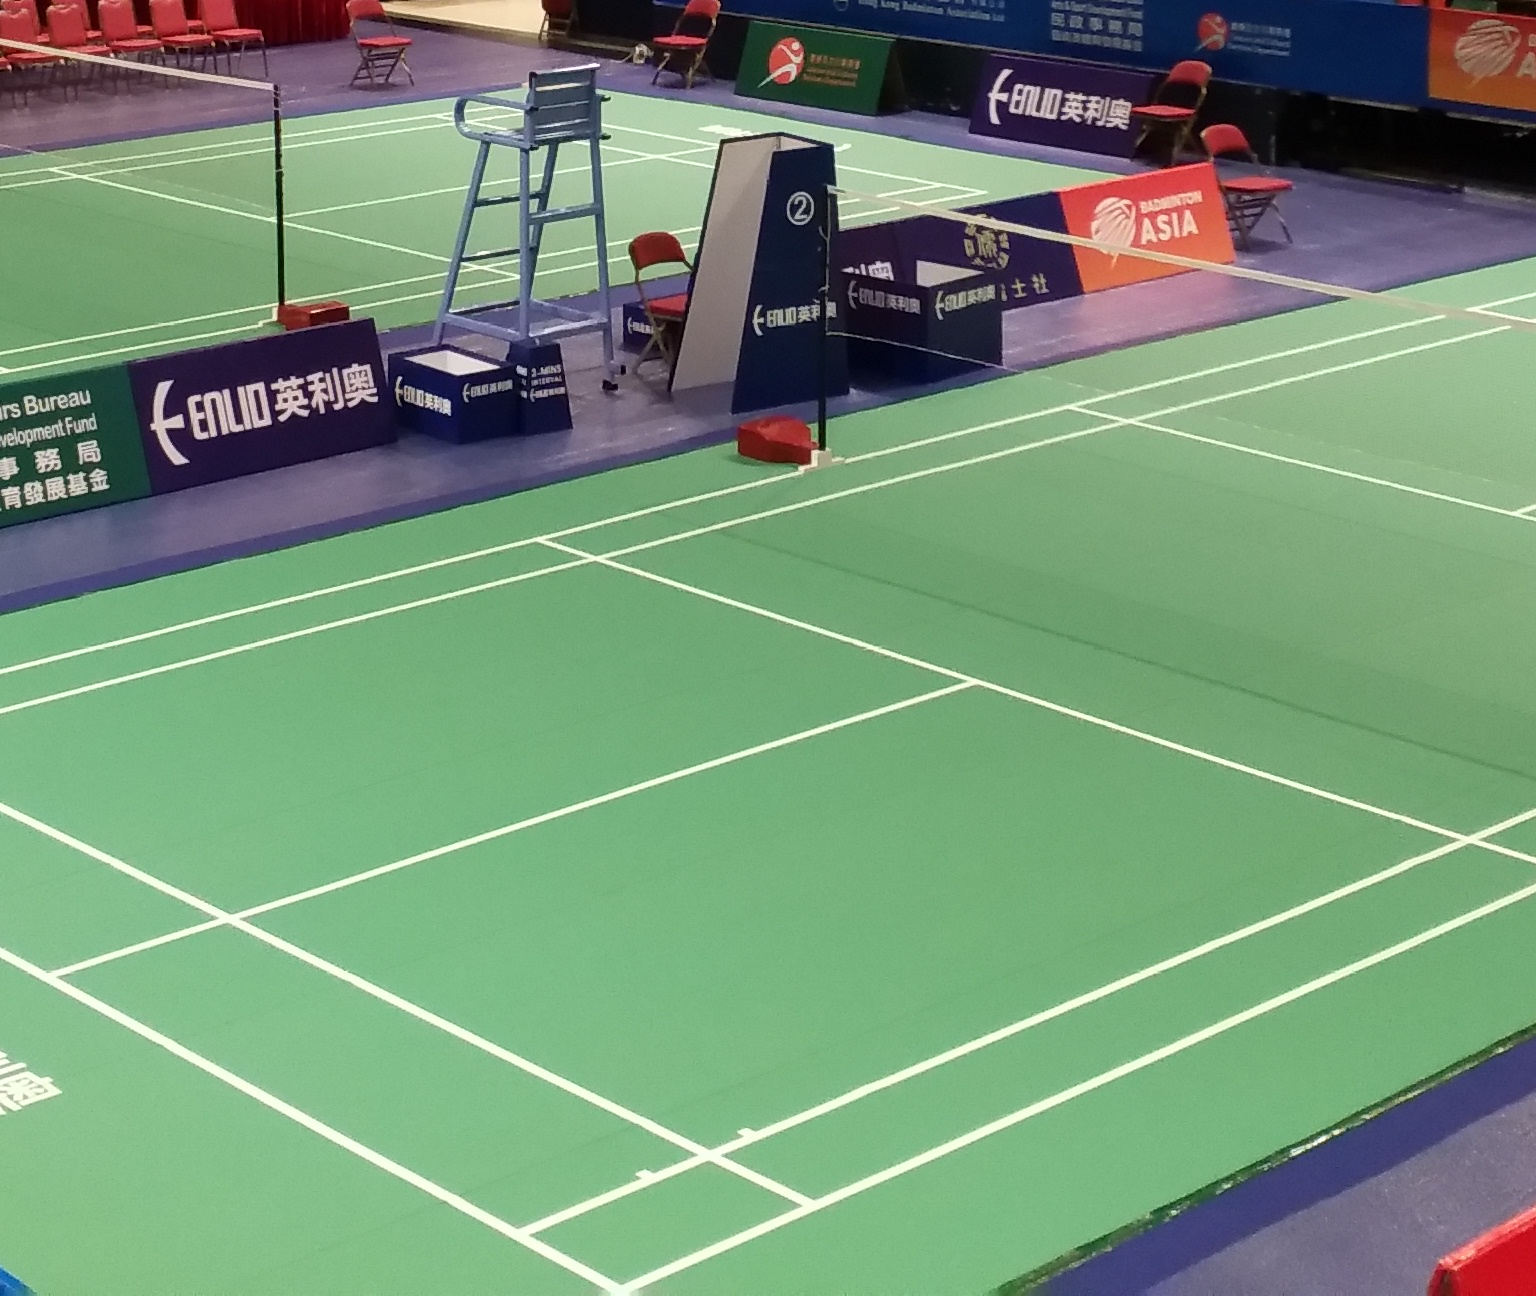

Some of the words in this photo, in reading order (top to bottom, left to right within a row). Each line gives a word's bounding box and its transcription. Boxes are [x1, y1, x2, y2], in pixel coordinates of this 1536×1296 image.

[1139, 190, 1204, 215] BADMINTON
[1139, 209, 1200, 243] ASIA
[23, 389, 92, 416] Bureau
[189, 381, 272, 442] ENLIO
[65, 412, 98, 437] Fund
